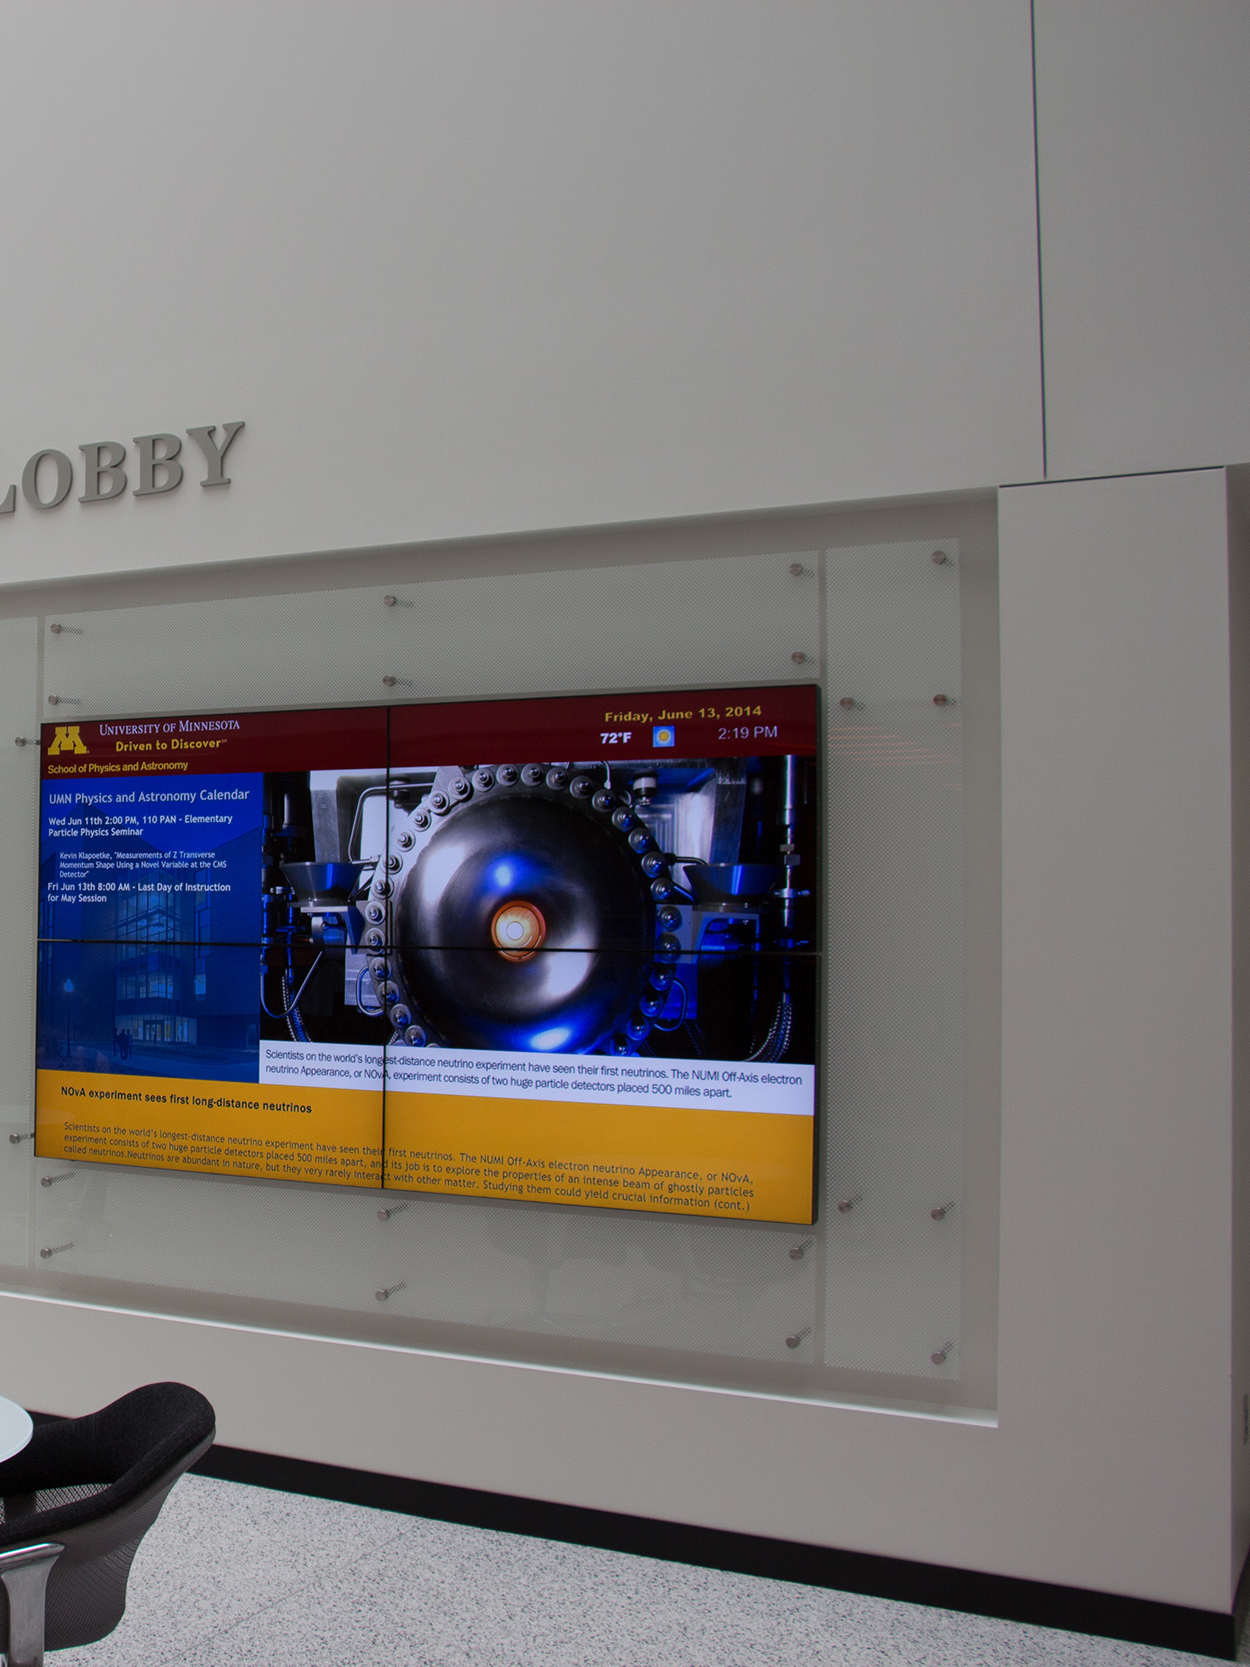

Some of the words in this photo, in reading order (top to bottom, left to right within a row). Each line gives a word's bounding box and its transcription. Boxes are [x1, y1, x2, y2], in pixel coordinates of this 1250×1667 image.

[605, 712, 653, 722] Friday,
[658, 710, 693, 720] June
[699, 708, 720, 719] 13,
[726, 706, 761, 717] 2014
[99, 724, 160, 735] UNIVERSITY
[162, 723, 176, 733] OF
[180, 720, 240, 731] MINNESOTA
[718, 727, 749, 739] 2:19
[754, 726, 777, 737] PM
[600, 732, 632, 744] 72°F
[116, 741, 152, 751] Driven
[156, 740, 167, 750] to
[171, 739, 221, 749] Discover
[47, 765, 76, 774] School
[77, 764, 87, 773] of
[88, 763, 121, 774] Physics
[122, 762, 139, 771] and
[140, 762, 188, 771] Astronomy
[49, 794, 72, 804] UMN
[75, 793, 112, 805] Physics
[115, 792, 135, 802] and
[138, 792, 196, 803] Astronomy
[200, 789, 249, 800] Calendar
[48, 817, 66, 825] Wed
[68, 817, 82, 825] Jun
[84, 817, 102, 825] 11th
[104, 816, 123, 825] 2:00
[125, 816, 139, 825] PM,
[143, 815, 158, 824] 110
[160, 815, 176, 824] PAN
[184, 815, 233, 824] Elementary
[48, 828, 78, 836] Particle
[80, 828, 109, 838] Physics
[109, 828, 144, 836] Seminar
[46, 882, 58, 890] Fri
[61, 883, 75, 891] Jun
[78, 882, 96, 891] 13th
[98, 882, 116, 891] 8:00
[118, 883, 130, 891] AM
[138, 883, 154, 891] Last
[157, 882, 172, 893] Day
[174, 882, 183, 891] of
[185, 883, 231, 892] Instruction
[48, 894, 59, 902] for
[61, 894, 76, 904] May
[78, 894, 107, 902] Session
[266, 1050, 305, 1060] Scientists
[305, 1053, 316, 1061] on
[318, 1053, 332, 1062] the
[333, 1054, 363, 1063] world's
[365, 1055, 435, 1067] longest-distance
[438, 1059, 475, 1069] neutrino
[474, 1061, 526, 1072] experiment
[528, 1063, 552, 1074] have
[551, 1064, 575, 1074] seen
[577, 1065, 599, 1076] their
[600, 1066, 620, 1078] first
[620, 1068, 668, 1079] neutrinos.
[671, 1068, 689, 1080] The
[692, 1070, 720, 1081] NUMI
[722, 1071, 759, 1083] Off-Axis
[760, 1074, 803, 1085] electron
[265, 1065, 300, 1074] neutrino
[299, 1066, 351, 1078] Appearance,
[353, 1070, 362, 1078] or
[364, 1069, 391, 1082] NOvA,
[393, 1072, 443, 1082] experiment
[442, 1075, 480, 1085] consists
[480, 1075, 491, 1086] of
[491, 1077, 510, 1086] two
[509, 1077, 535, 1089] huge
[534, 1079, 570, 1090] particle
[569, 1080, 617, 1093] detectors
[616, 1083, 649, 1095] placed
[652, 1083, 672, 1094] 500
[673, 1086, 702, 1097] miles
[702, 1088, 732, 1098] apart.
[61, 1087, 86, 1097] NOvA
[89, 1090, 142, 1101] experiment
[145, 1094, 167, 1103] sees
[170, 1094, 189, 1104] first
[192, 1097, 259, 1109] long-distance
[262, 1103, 312, 1113] neutrinos
[483, 1181, 524, 1194] Studying
[526, 1184, 552, 1194] them
[553, 1187, 582, 1197] could
[584, 1190, 609, 1200] yield
[612, 1193, 646, 1202] crucial
[650, 1194, 710, 1207] information
[714, 1200, 750, 1212] (cont.)
